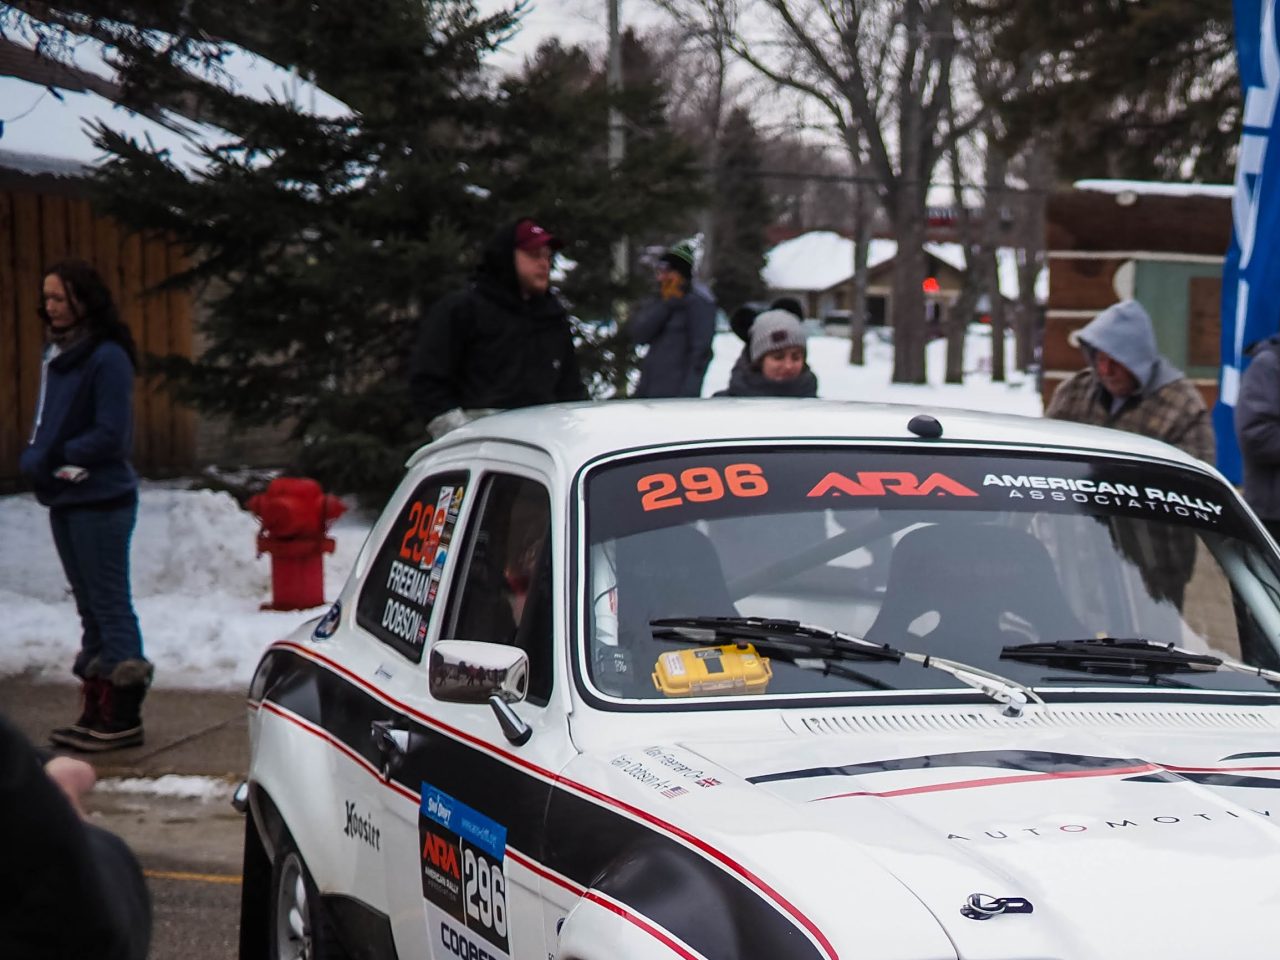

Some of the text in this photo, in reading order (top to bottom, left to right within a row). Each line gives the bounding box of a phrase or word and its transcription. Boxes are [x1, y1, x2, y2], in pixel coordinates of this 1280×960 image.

[637, 463, 768, 511] 296
[806, 472, 980, 497] ARA
[983, 474, 1223, 516] AMERICAN RALLY
[1009, 489, 1210, 523] ASSOCIATION
[386, 560, 430, 607] FREEMAN
[381, 598, 423, 644] DOBSON
[423, 831, 460, 880] ARA
[464, 848, 506, 938] 296
